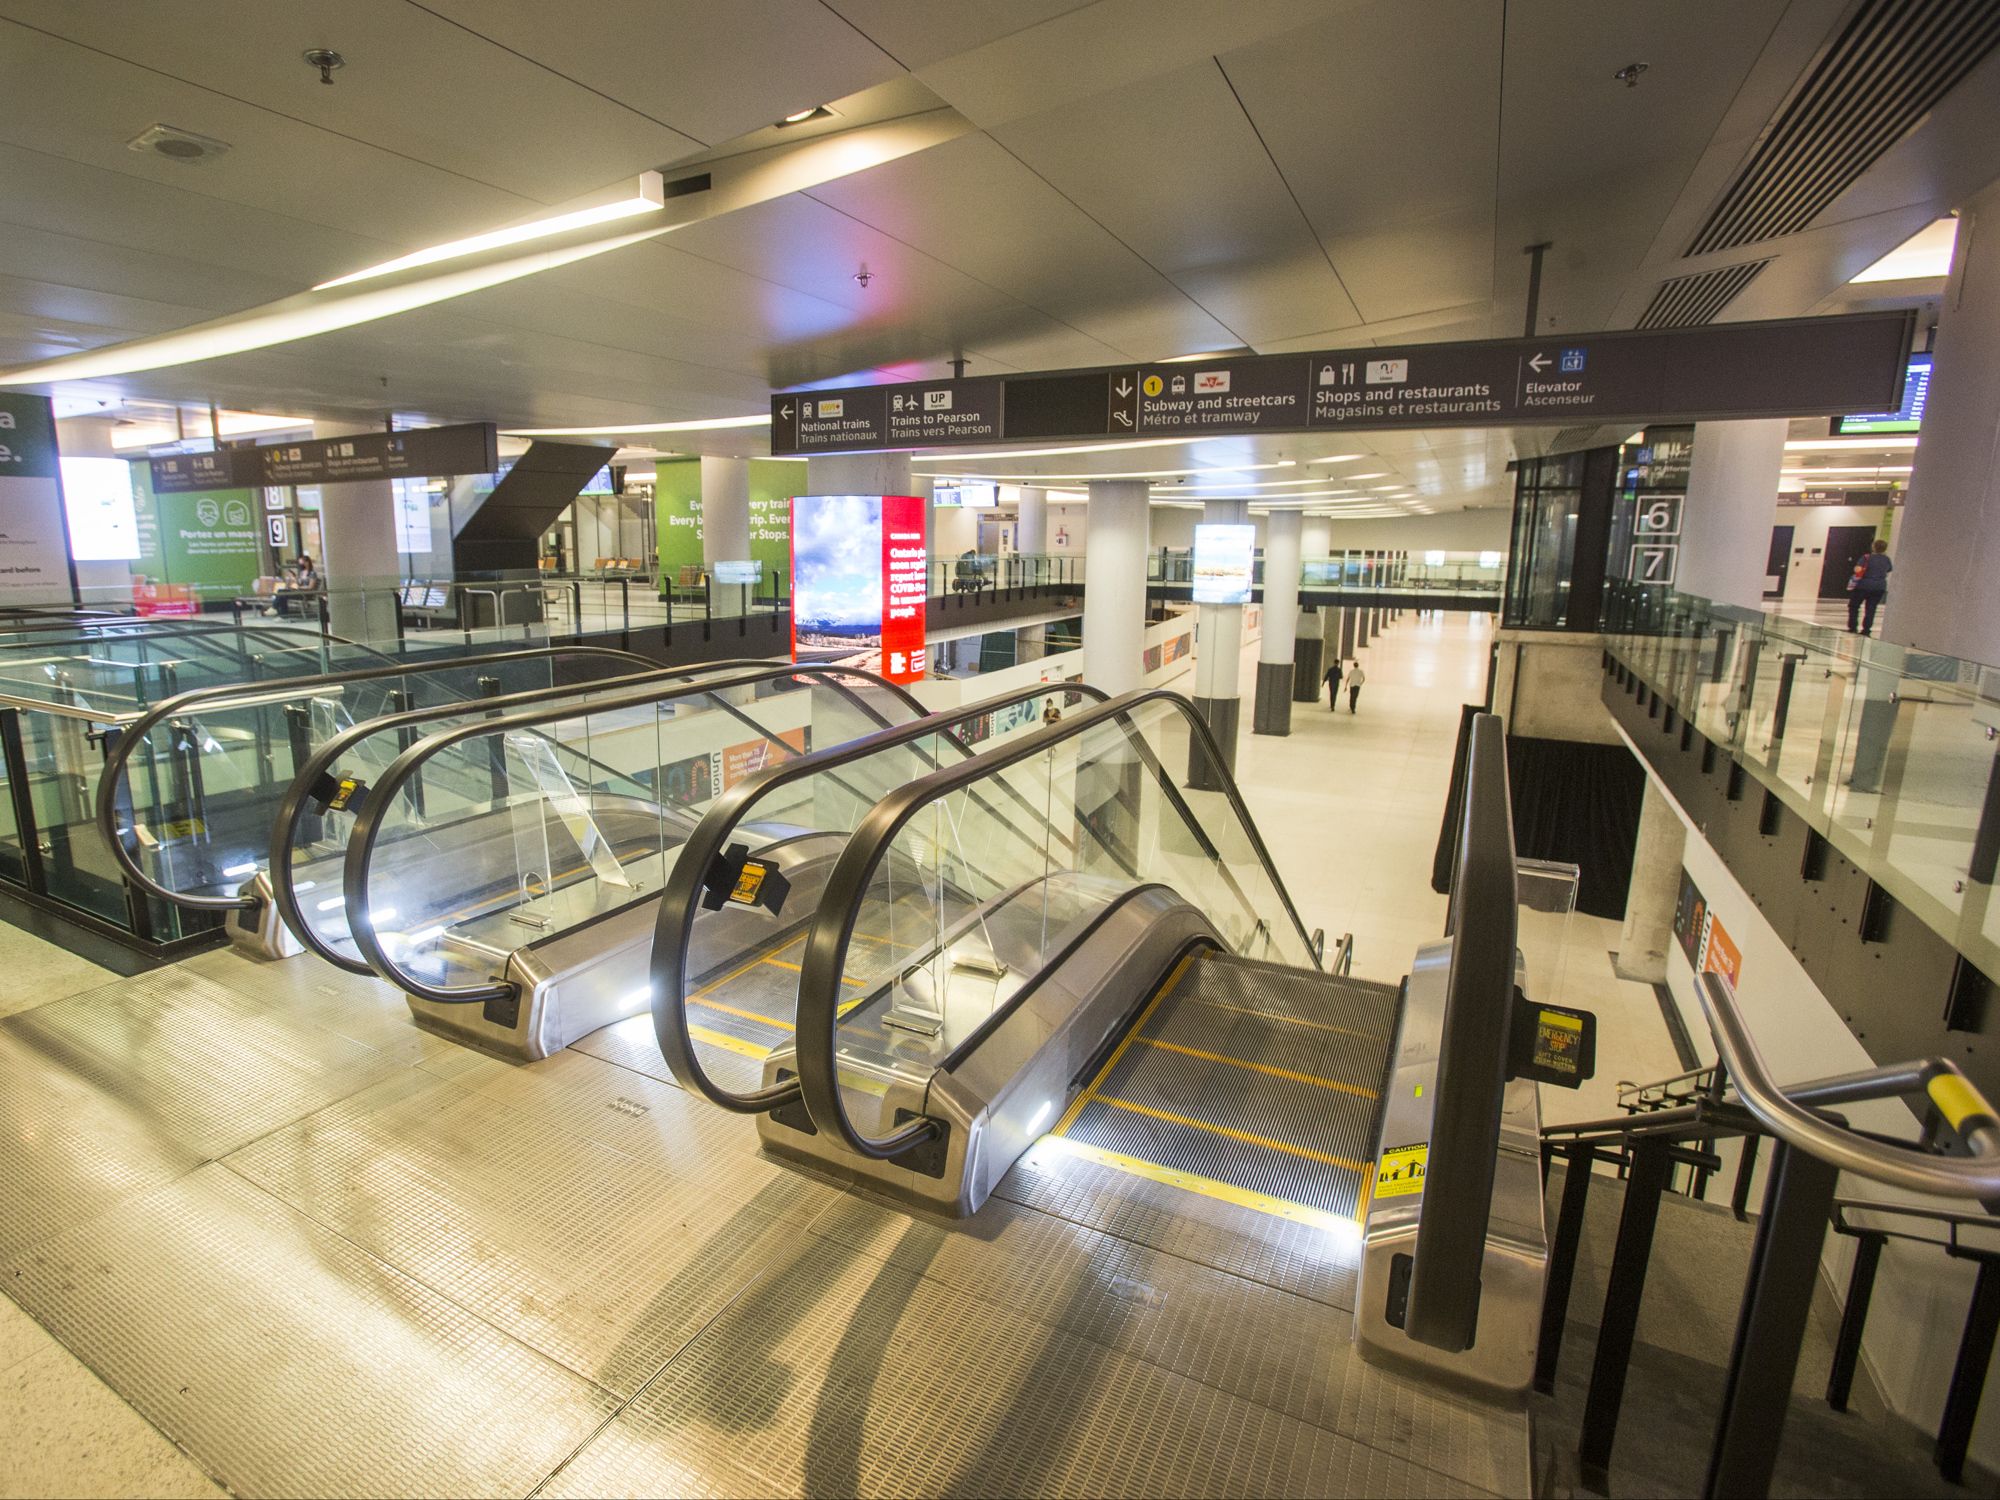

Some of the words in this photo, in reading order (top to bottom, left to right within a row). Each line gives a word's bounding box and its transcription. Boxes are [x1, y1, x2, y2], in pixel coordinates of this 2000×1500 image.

[1316, 391, 1361, 405] Shops
[1366, 388, 1394, 401] and
[1398, 384, 1490, 400] restaurants
[1526, 382, 1582, 394] Elevator
[930, 393, 945, 404] UP
[1144, 400, 1194, 412] Subway
[1197, 397, 1222, 409] and
[1226, 394, 1296, 407] streetcars
[1524, 394, 1595, 406] Ascenseur
[1316, 404, 1384, 420] Magasins
[1388, 403, 1404, 416] et
[1409, 399, 1501, 414] restaurants
[801, 420, 840, 432] National
[842, 418, 870, 430] trains
[891, 416, 920, 426] Trains
[923, 414, 934, 424] to
[936, 413, 980, 424] Pearson
[1144, 412, 1180, 426] Métro
[1184, 412, 1198, 424] et
[1202, 410, 1260, 424] tramway
[801, 434, 828, 444] Trains
[830, 431, 878, 442] nationaux
[891, 428, 920, 438] Trains
[923, 427, 945, 436] vers
[948, 424, 992, 435] Pearson
[269, 486, 280, 504] 8
[670, 515, 696, 528] Every
[750, 514, 768, 528] rip.
[769, 514, 790, 524] Ever
[1649, 502, 1670, 530] 6
[272, 520, 283, 542] 9
[759, 528, 790, 542] Stops.
[1642, 551, 1664, 578] 7
[712, 752, 722, 796] Union
[1539, 1027, 1580, 1045] EMERGENCY
[1550, 1040, 1568, 1053] STOP
[1388, 1144, 1427, 1154] CAUTION
